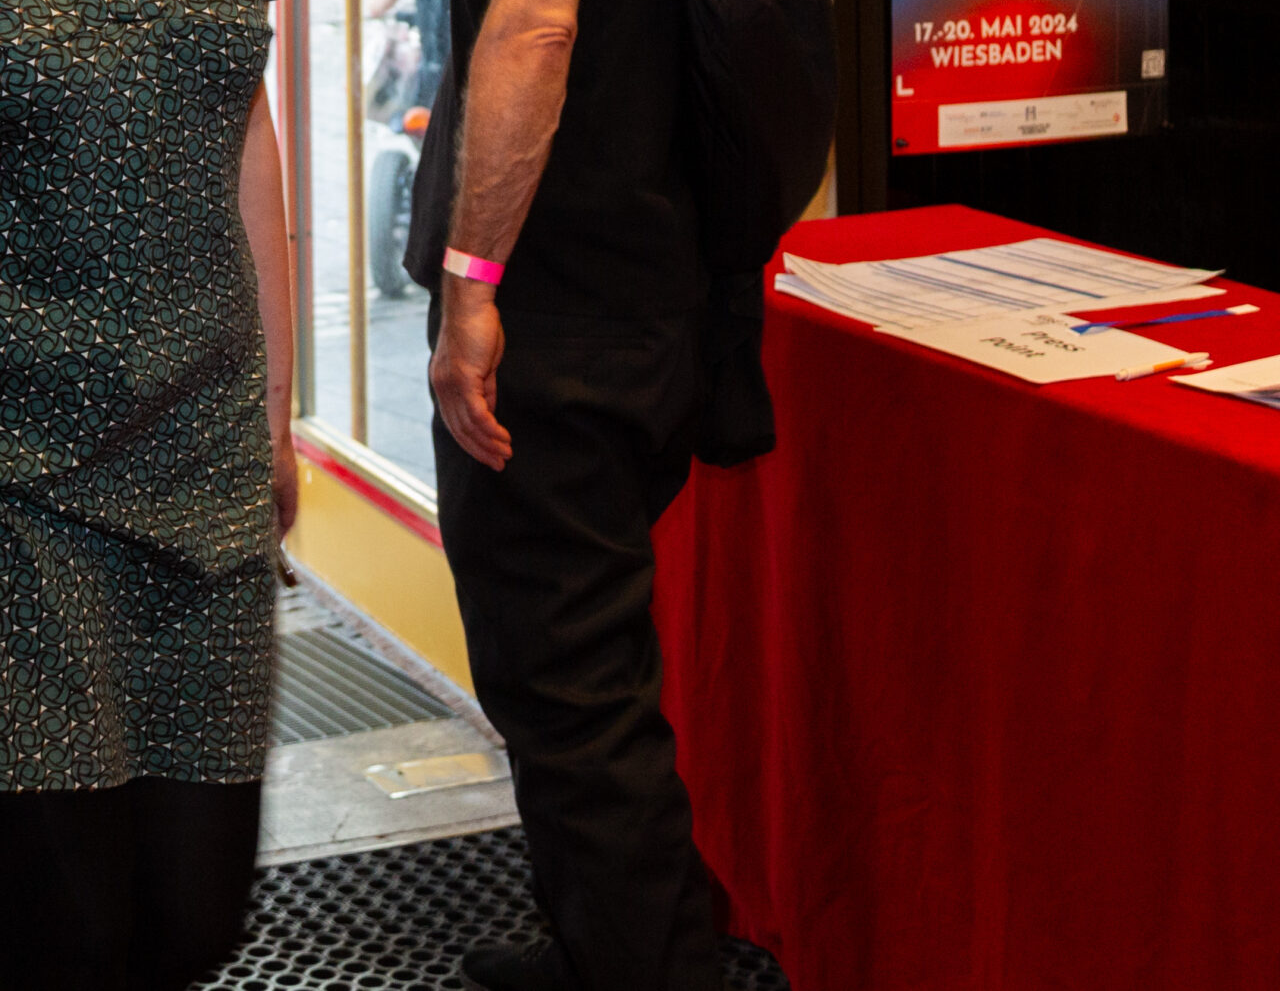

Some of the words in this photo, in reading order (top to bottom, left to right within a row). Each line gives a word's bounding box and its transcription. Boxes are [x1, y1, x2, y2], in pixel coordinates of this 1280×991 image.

[914, 19, 975, 42] 17.-20.
[981, 15, 1023, 39] MAI
[1028, 13, 1078, 35] 2024
[931, 38, 1062, 68] WIESBADEN
[1021, 330, 1085, 352] Press
